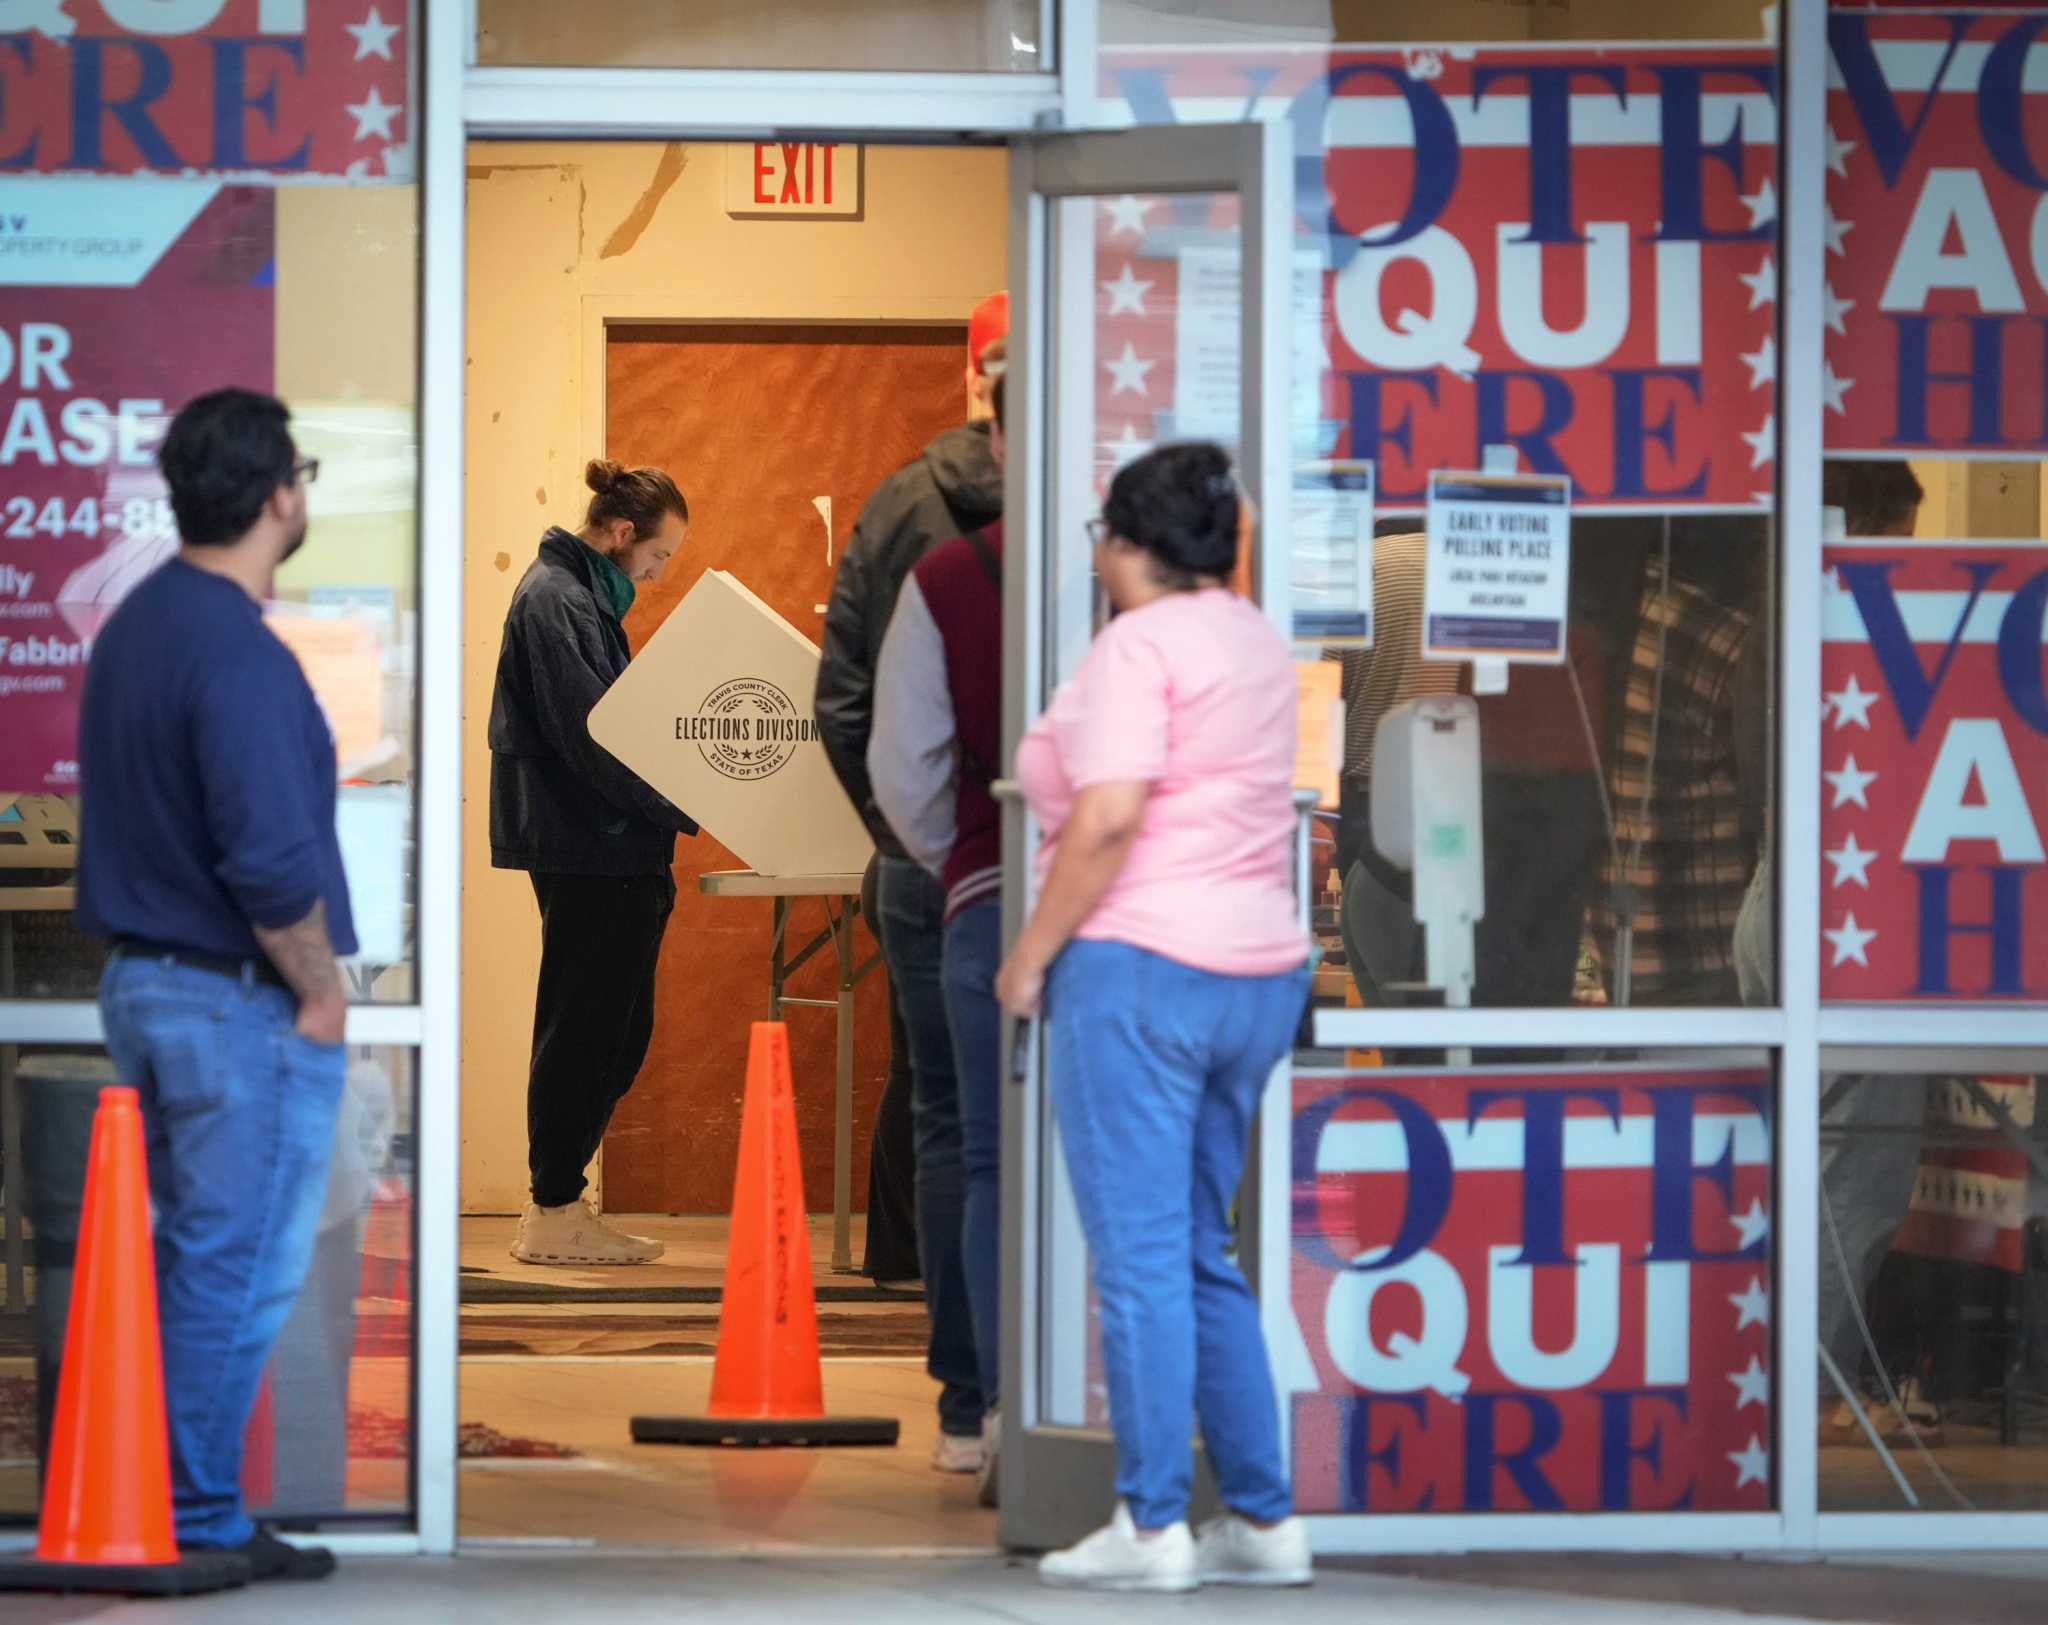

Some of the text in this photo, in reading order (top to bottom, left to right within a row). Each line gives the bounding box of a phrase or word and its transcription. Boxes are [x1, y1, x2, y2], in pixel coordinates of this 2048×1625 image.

[754, 143, 840, 204] EXIT
[1321, 221, 1702, 381] QUI
[1338, 369, 1713, 500] ERE
[1445, 536, 1551, 561] POLLING PLACE
[1449, 511, 1549, 535] EARLY VOTING
[708, 683, 788, 710] TRAVIS COUNTY CLERK
[675, 717, 820, 742] ELECTIONS DIVISION
[710, 752, 784, 776] STATE OF TEXAS
[1291, 1084, 1769, 1272] OTE
[1291, 1241, 1692, 1404] QUI
[1337, 1389, 1697, 1509] ERE
